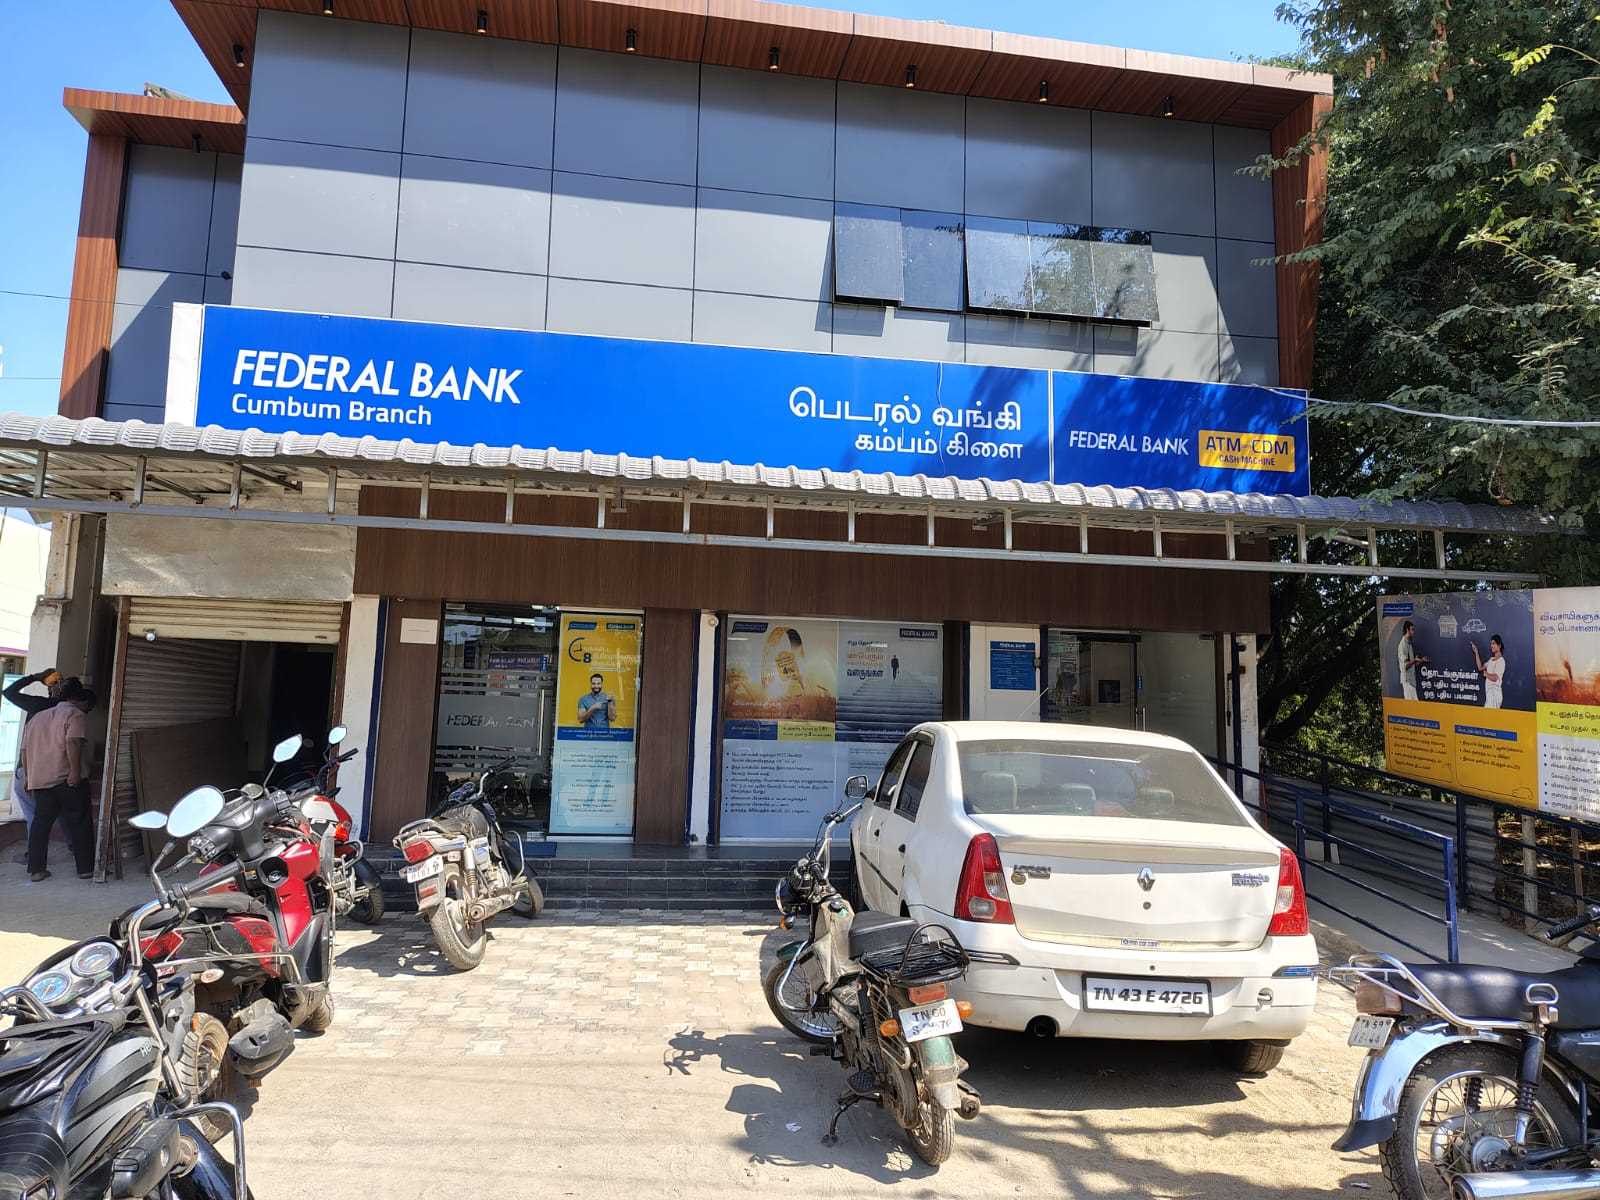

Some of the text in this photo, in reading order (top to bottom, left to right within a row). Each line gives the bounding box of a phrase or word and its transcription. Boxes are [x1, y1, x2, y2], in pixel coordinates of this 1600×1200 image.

[232, 349, 524, 404] FEDERAL BANK
[232, 392, 432, 426] Cumbum Branch
[788, 386, 1021, 431] பெடரல் வங்கி
[855, 427, 1023, 459] கம்பம் கிளை
[1069, 430, 1190, 456] FEDERAL BANK
[1220, 455, 1276, 467] CASH MACHINE
[1093, 987, 1203, 1005] TN 43 E 4726
